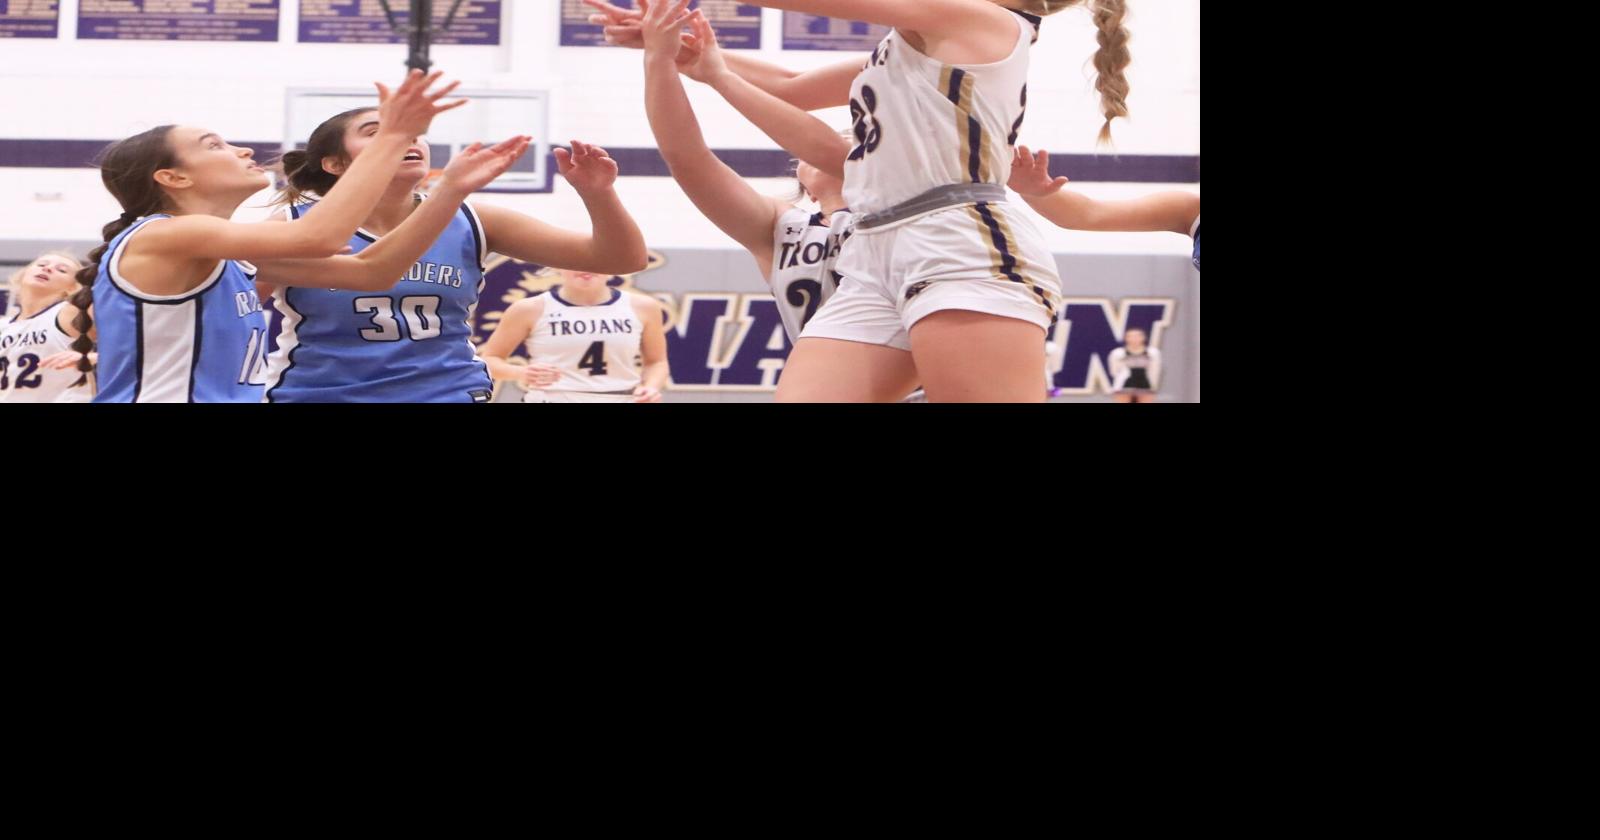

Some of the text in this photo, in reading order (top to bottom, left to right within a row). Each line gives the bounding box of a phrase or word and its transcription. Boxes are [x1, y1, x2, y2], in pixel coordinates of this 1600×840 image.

[353, 295, 442, 342] 30
[548, 319, 632, 336] TROJANS
[0, 329, 47, 350] OJANS
[577, 340, 608, 376] 4
